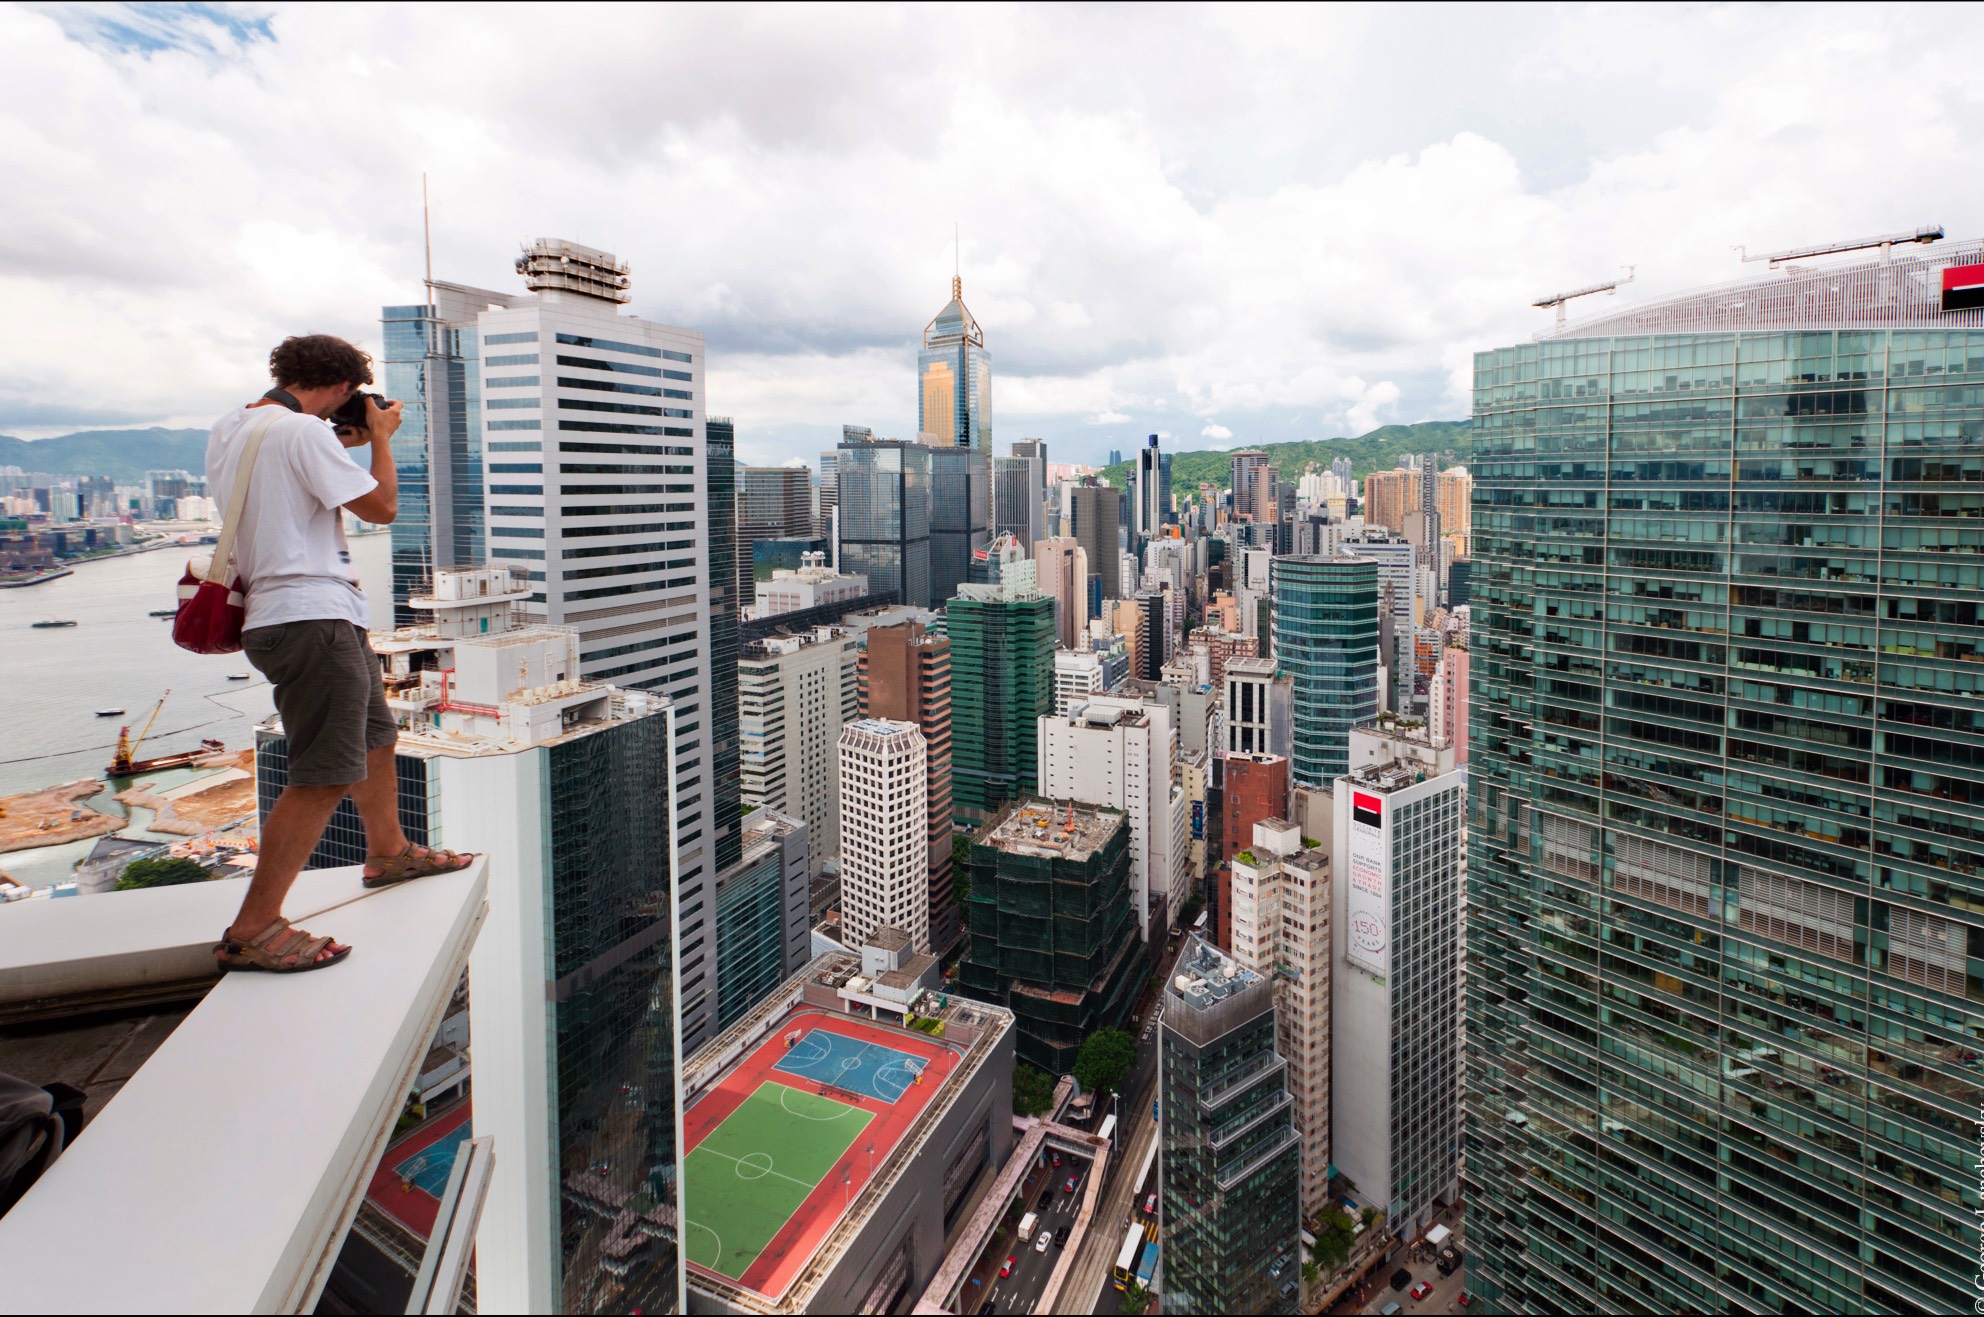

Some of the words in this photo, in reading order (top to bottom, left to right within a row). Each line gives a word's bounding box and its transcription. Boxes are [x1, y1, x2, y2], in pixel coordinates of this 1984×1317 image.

[1353, 859, 1382, 873] SUPPORTS
[1366, 858, 1381, 866] BANK
[1353, 865, 1382, 879] ECONOMIC
[1353, 871, 1382, 885] GROWTH
[1353, 884, 1369, 893] SINCE
[1359, 879, 1382, 892] TRADE
[1354, 920, 1379, 937] 150
[1358, 935, 1379, 946] YEARS
